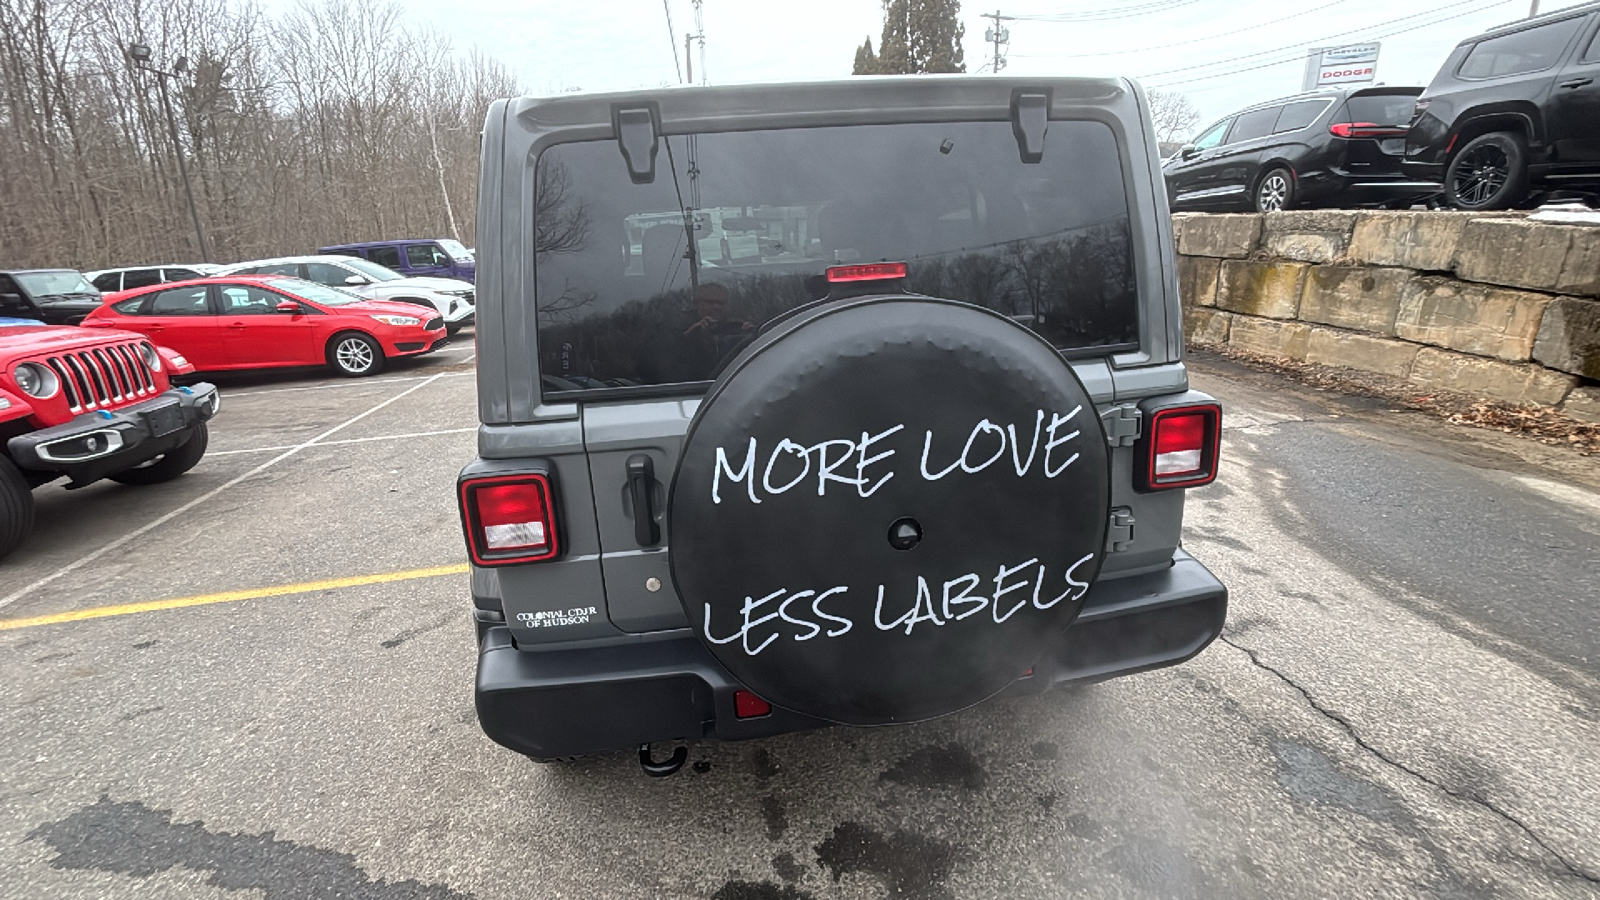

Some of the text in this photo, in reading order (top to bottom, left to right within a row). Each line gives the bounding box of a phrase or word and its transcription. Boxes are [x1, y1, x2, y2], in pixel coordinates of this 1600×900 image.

[1322, 68, 1373, 78] DODGE
[712, 404, 1081, 504] MORE LOVE
[704, 553, 1094, 656] LESS LABELS
[516, 610, 567, 621] COLONIAL
[526, 615, 589, 628] OF HUDSON
